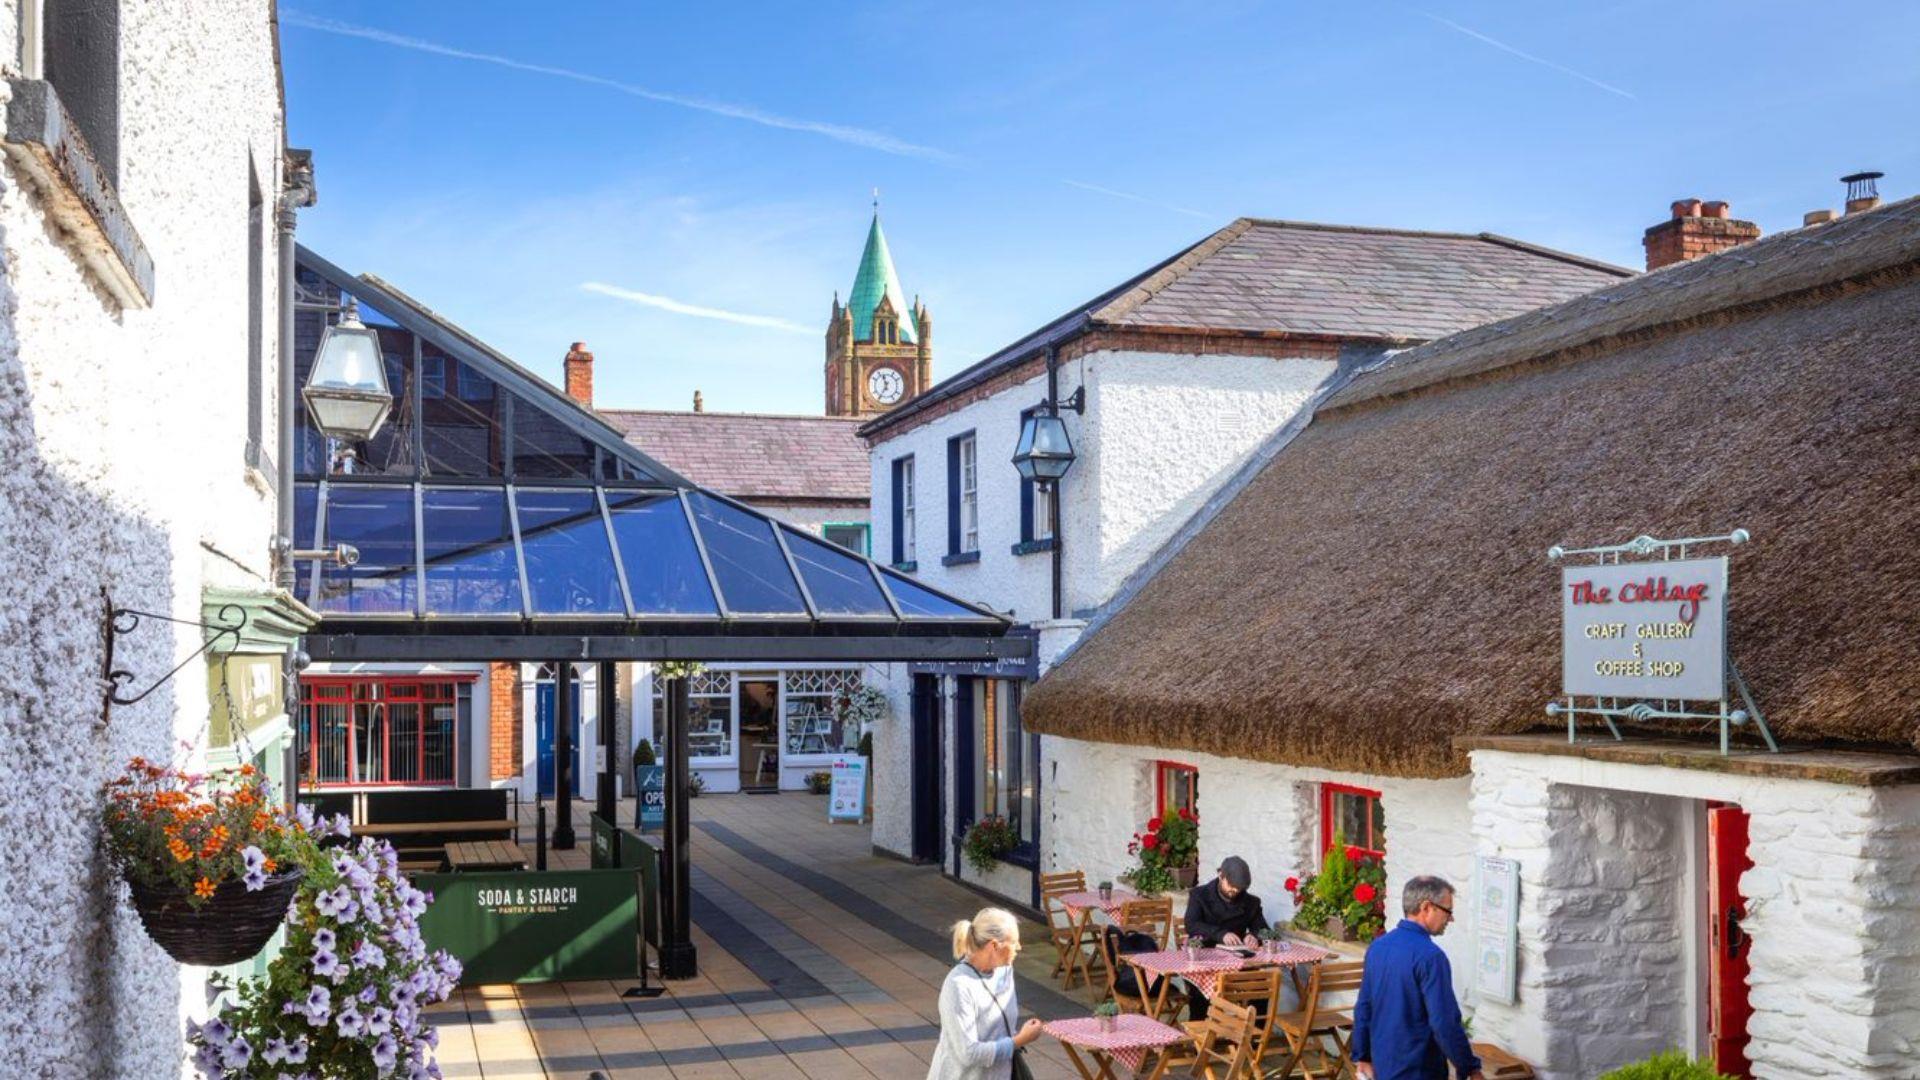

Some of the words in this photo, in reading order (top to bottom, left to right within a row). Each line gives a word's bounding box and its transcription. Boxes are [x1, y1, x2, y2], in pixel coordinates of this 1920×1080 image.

[1569, 580, 1612, 604] The
[1618, 576, 1709, 623] Cottage
[1584, 623, 1626, 640] CRAFT
[1636, 622, 1695, 640] GALLERY
[1594, 660, 1643, 677] COFFEE
[1648, 661, 1684, 677] SHOP
[645, 791, 665, 804] OPE
[478, 889, 512, 906] SODA
[516, 888, 525, 905] &
[529, 887, 577, 905] STARCH
